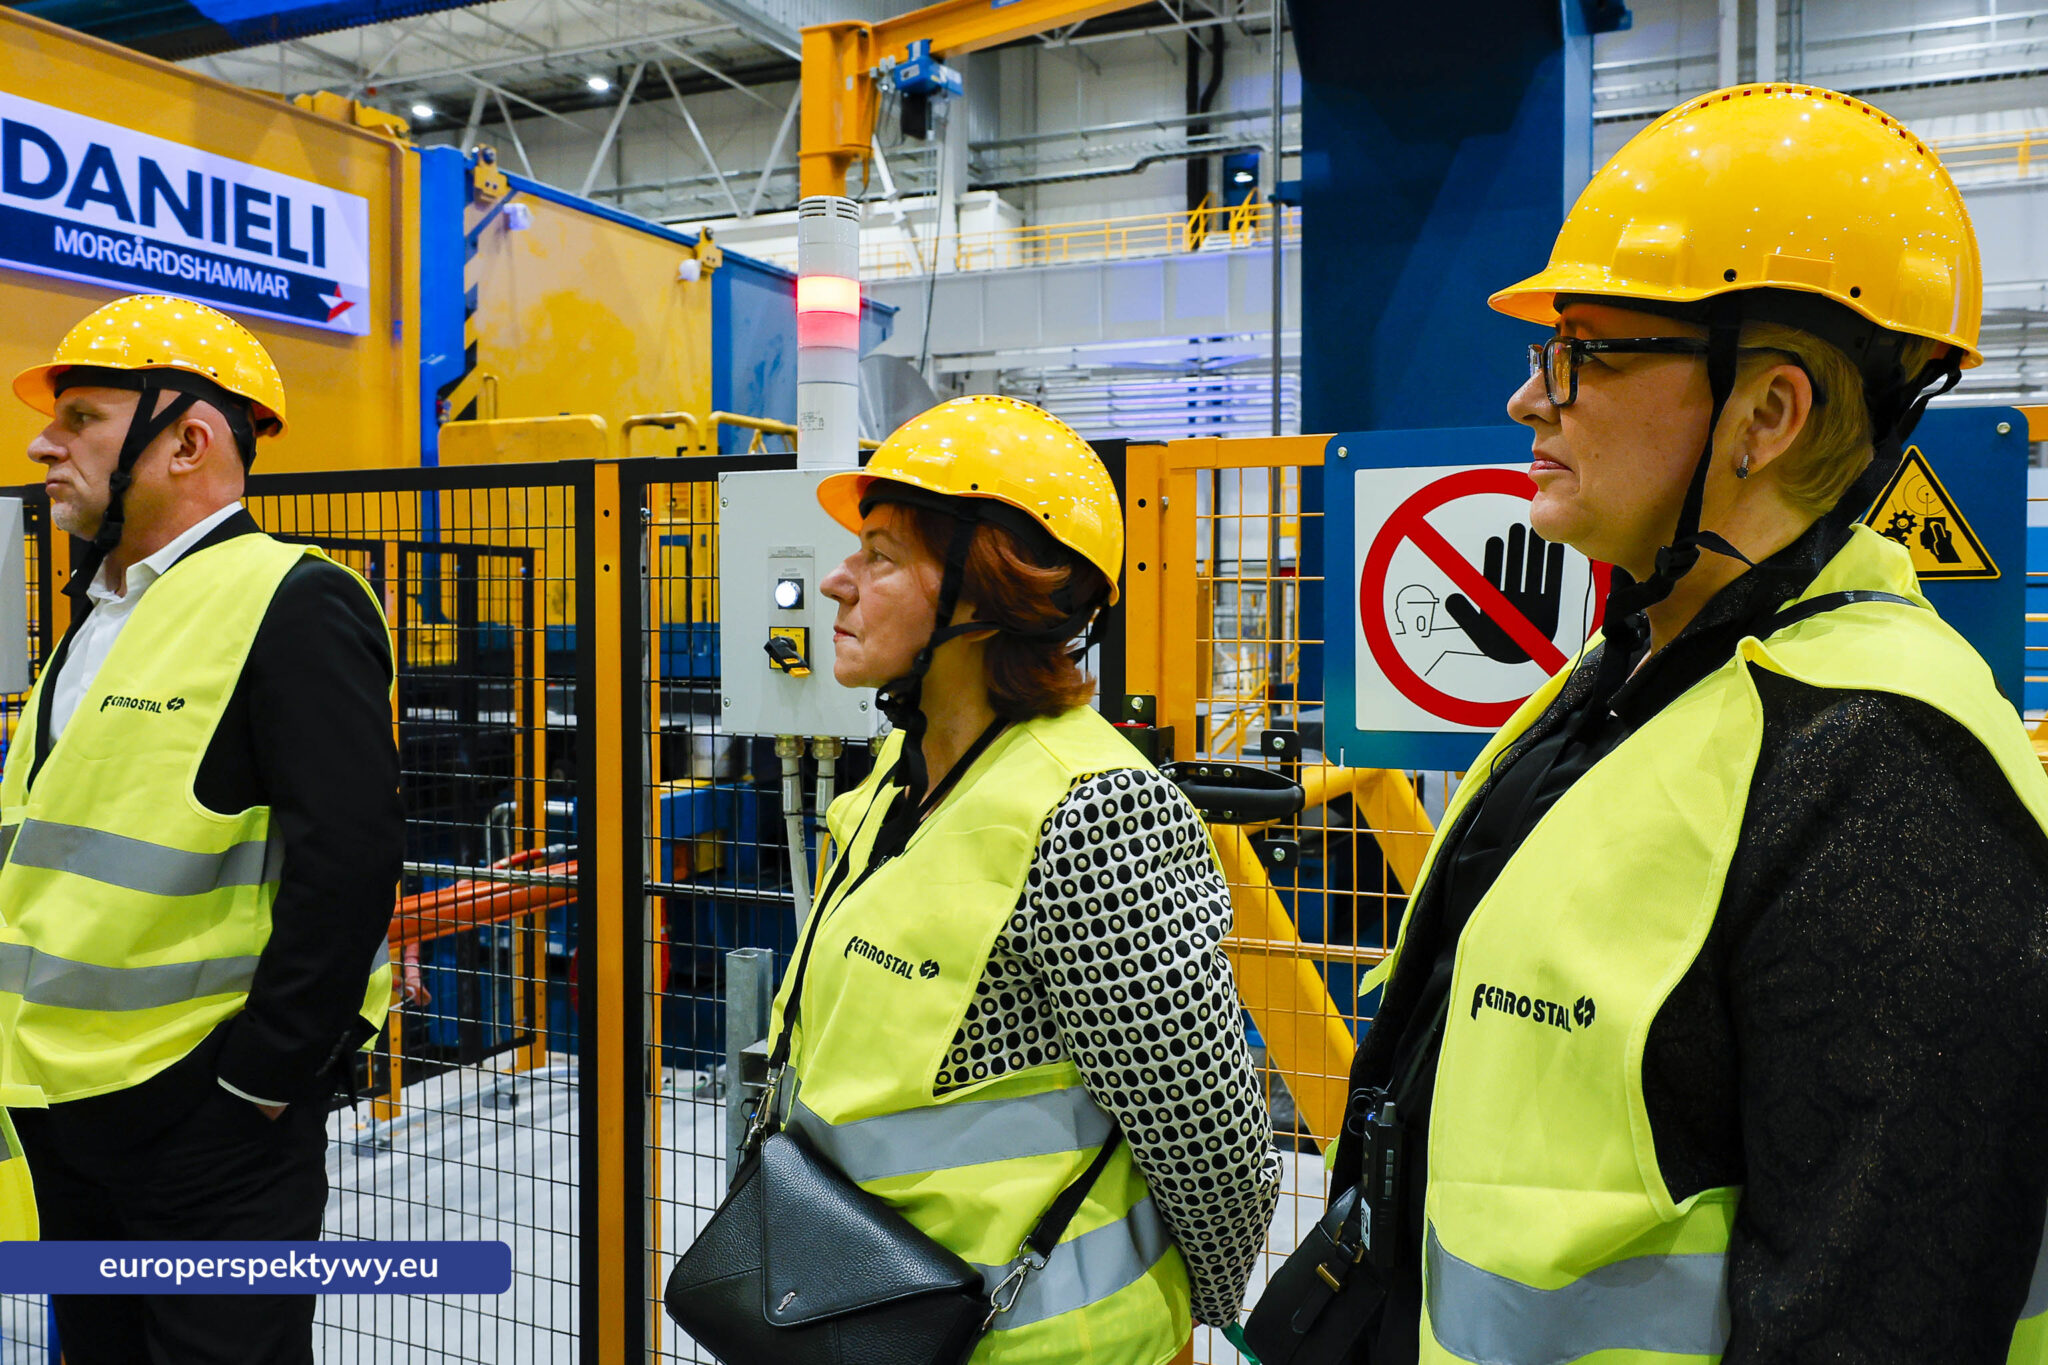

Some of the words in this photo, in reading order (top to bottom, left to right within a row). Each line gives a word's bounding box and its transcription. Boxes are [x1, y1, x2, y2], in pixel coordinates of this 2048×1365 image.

[1, 117, 327, 269] DANIELI
[54, 225, 290, 300] MORGÅRDSHAMMAR
[100, 695, 162, 714] FERROSTAL
[843, 935, 914, 980] FERROSTAL
[1470, 983, 1572, 1034] FERROSTAL
